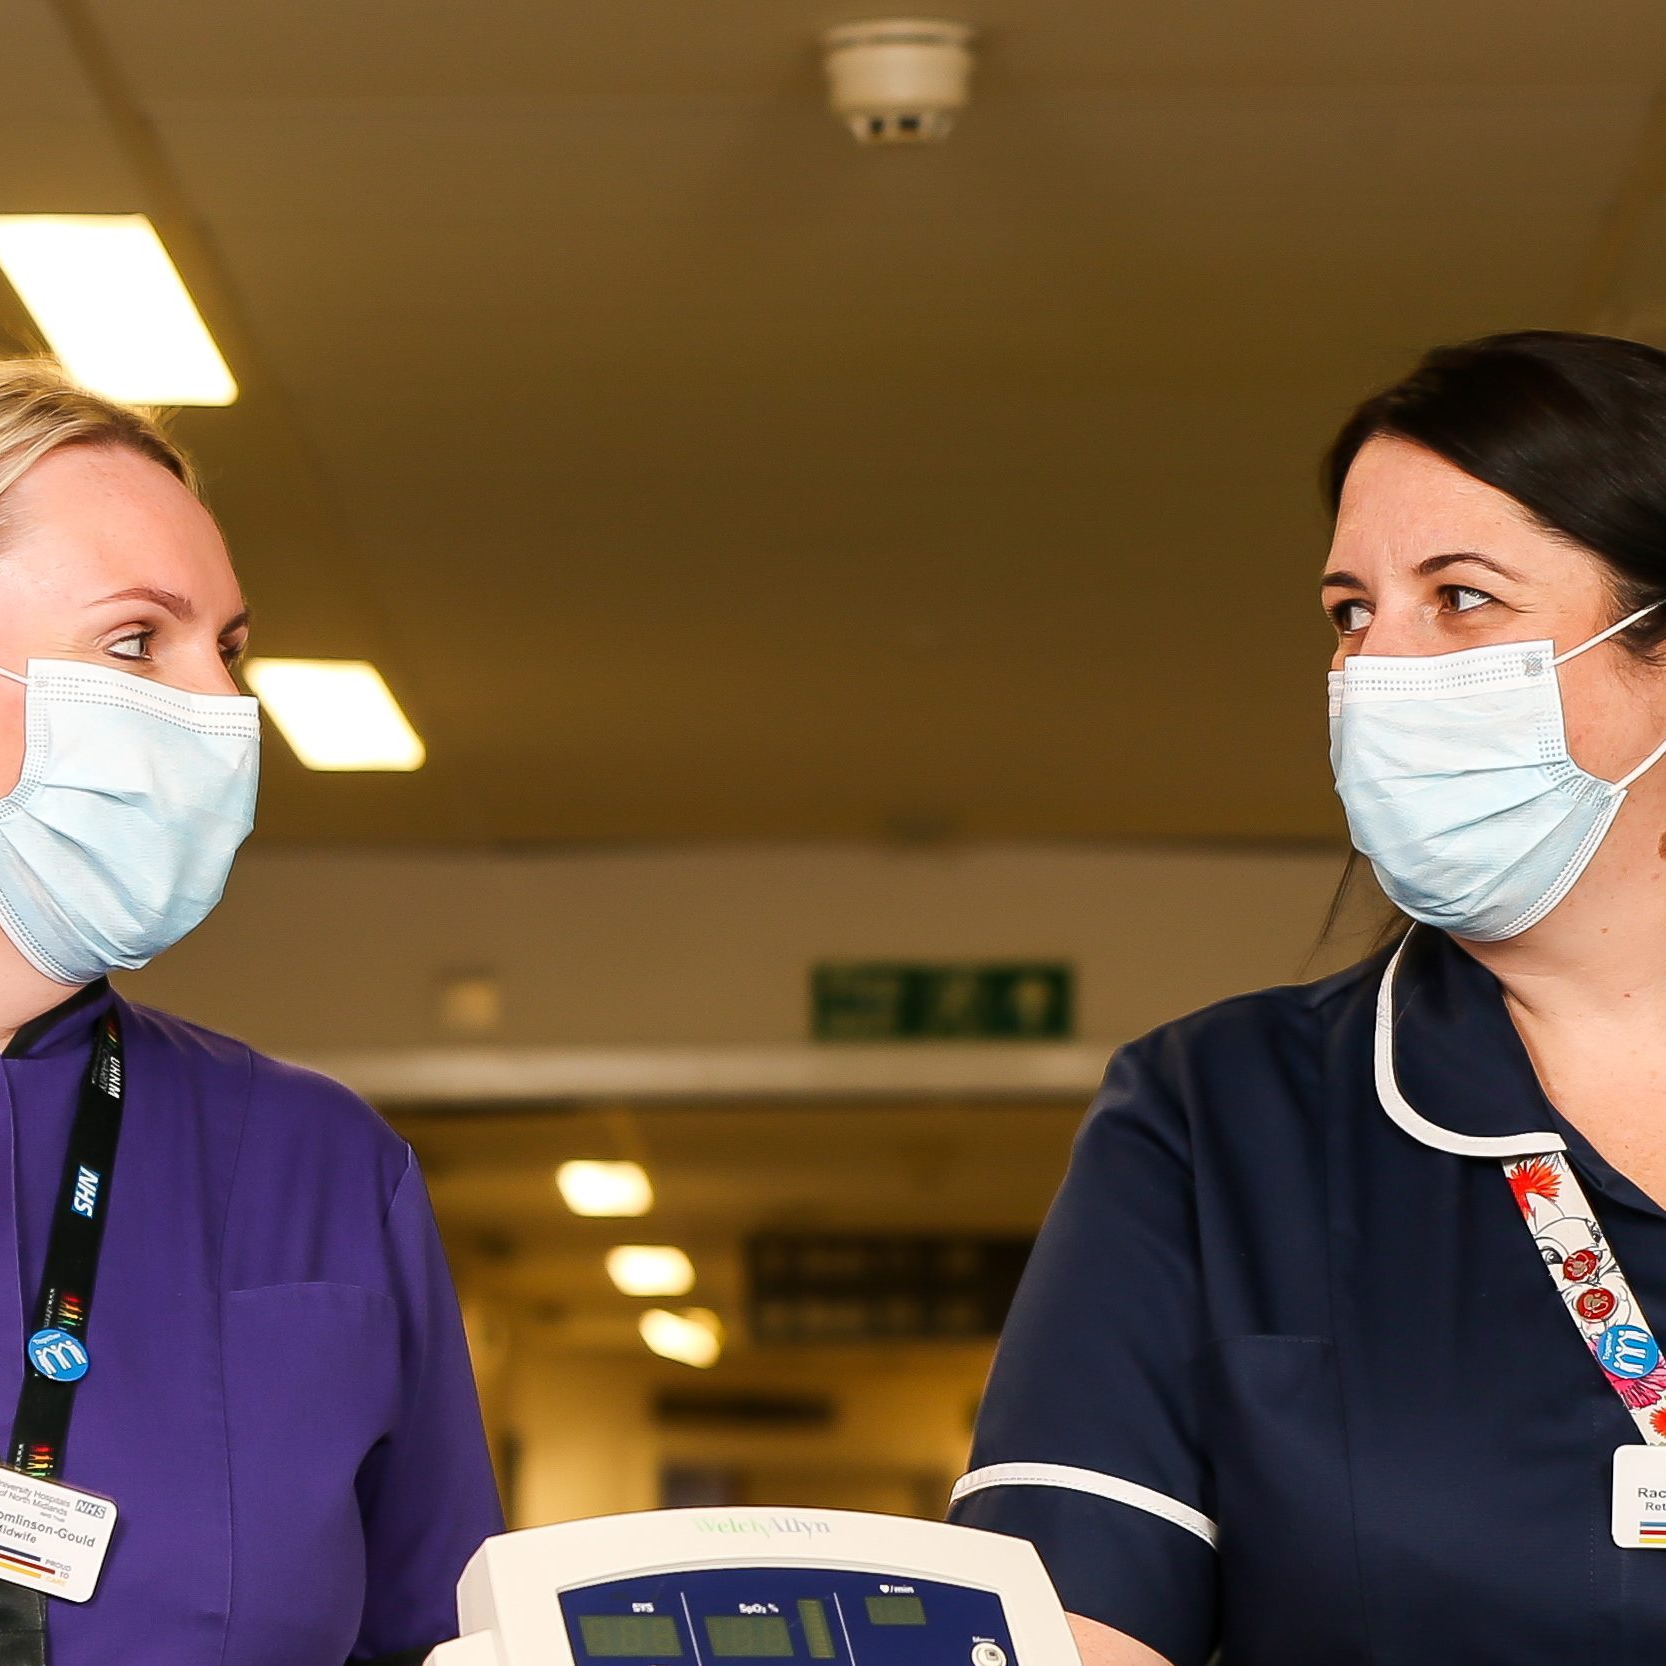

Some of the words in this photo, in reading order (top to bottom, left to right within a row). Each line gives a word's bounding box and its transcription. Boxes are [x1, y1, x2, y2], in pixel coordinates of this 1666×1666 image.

[107, 1056, 121, 1099] UHNM
[74, 1165, 99, 1218] NHS
[33, 1498, 68, 1517] Midlands
[34, 1489, 71, 1509] Hospitals
[75, 1500, 106, 1519] NHS
